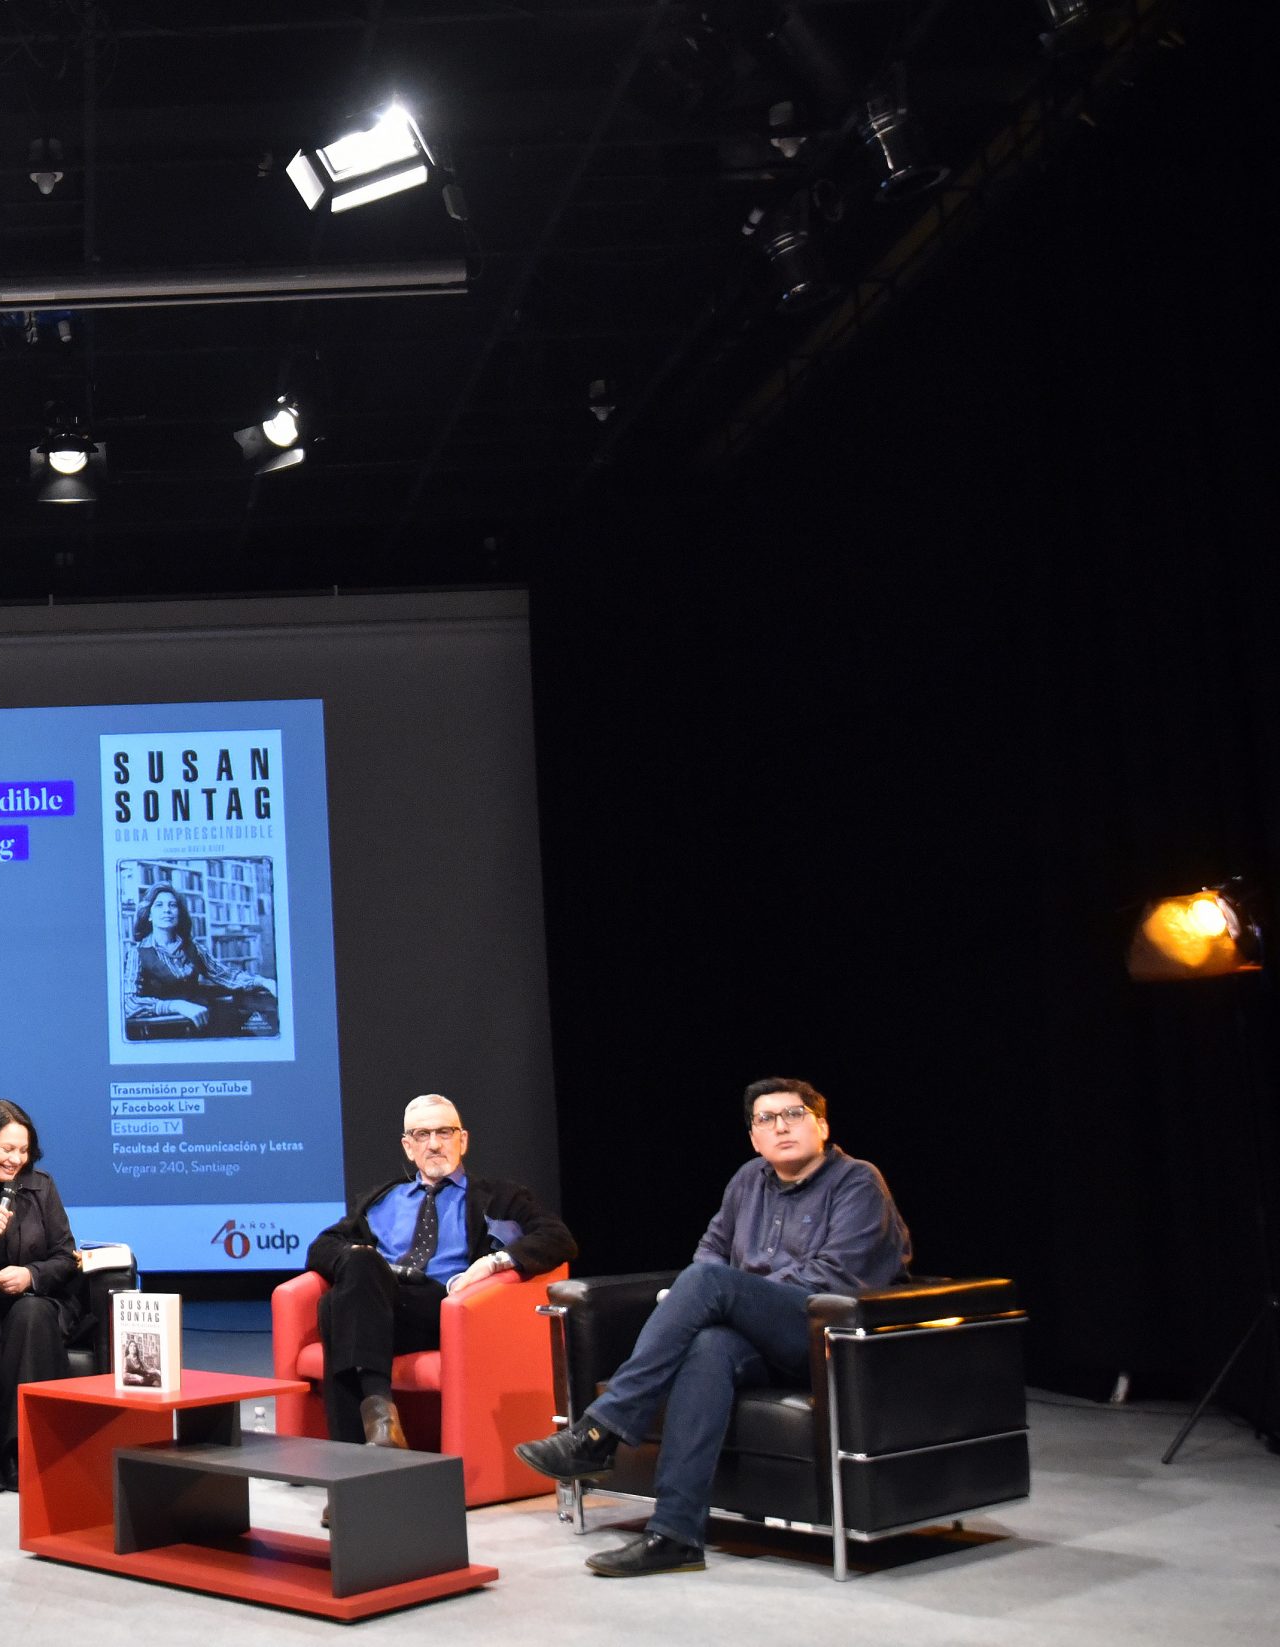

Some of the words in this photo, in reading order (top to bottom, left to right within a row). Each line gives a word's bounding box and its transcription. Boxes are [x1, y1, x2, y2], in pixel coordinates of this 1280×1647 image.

[113, 747, 270, 785] SUSAN
[114, 786, 272, 824] SONTAG
[114, 827, 149, 842] OBRA
[156, 824, 274, 841] IMPRESCINDIBLE
[112, 1083, 177, 1096] Transmisión
[180, 1086, 200, 1097] por
[202, 1082, 249, 1094] YouTube
[112, 1105, 119, 1116] y
[122, 1101, 175, 1113] Facebook
[178, 1101, 201, 1112] Live
[113, 1121, 160, 1134] Estudio
[163, 1121, 180, 1133] TV
[112, 1141, 160, 1155] Facultad
[162, 1141, 177, 1153] de
[178, 1139, 257, 1153] Comunicación
[259, 1142, 267, 1154] y
[269, 1140, 304, 1151] Letras
[112, 1161, 157, 1178] Vergara
[159, 1161, 188, 1175] 240,
[191, 1160, 241, 1177] Santiago
[256, 1228, 301, 1255] udp
[120, 1299, 160, 1311] SUSAN
[120, 1311, 161, 1323] SONTAG
